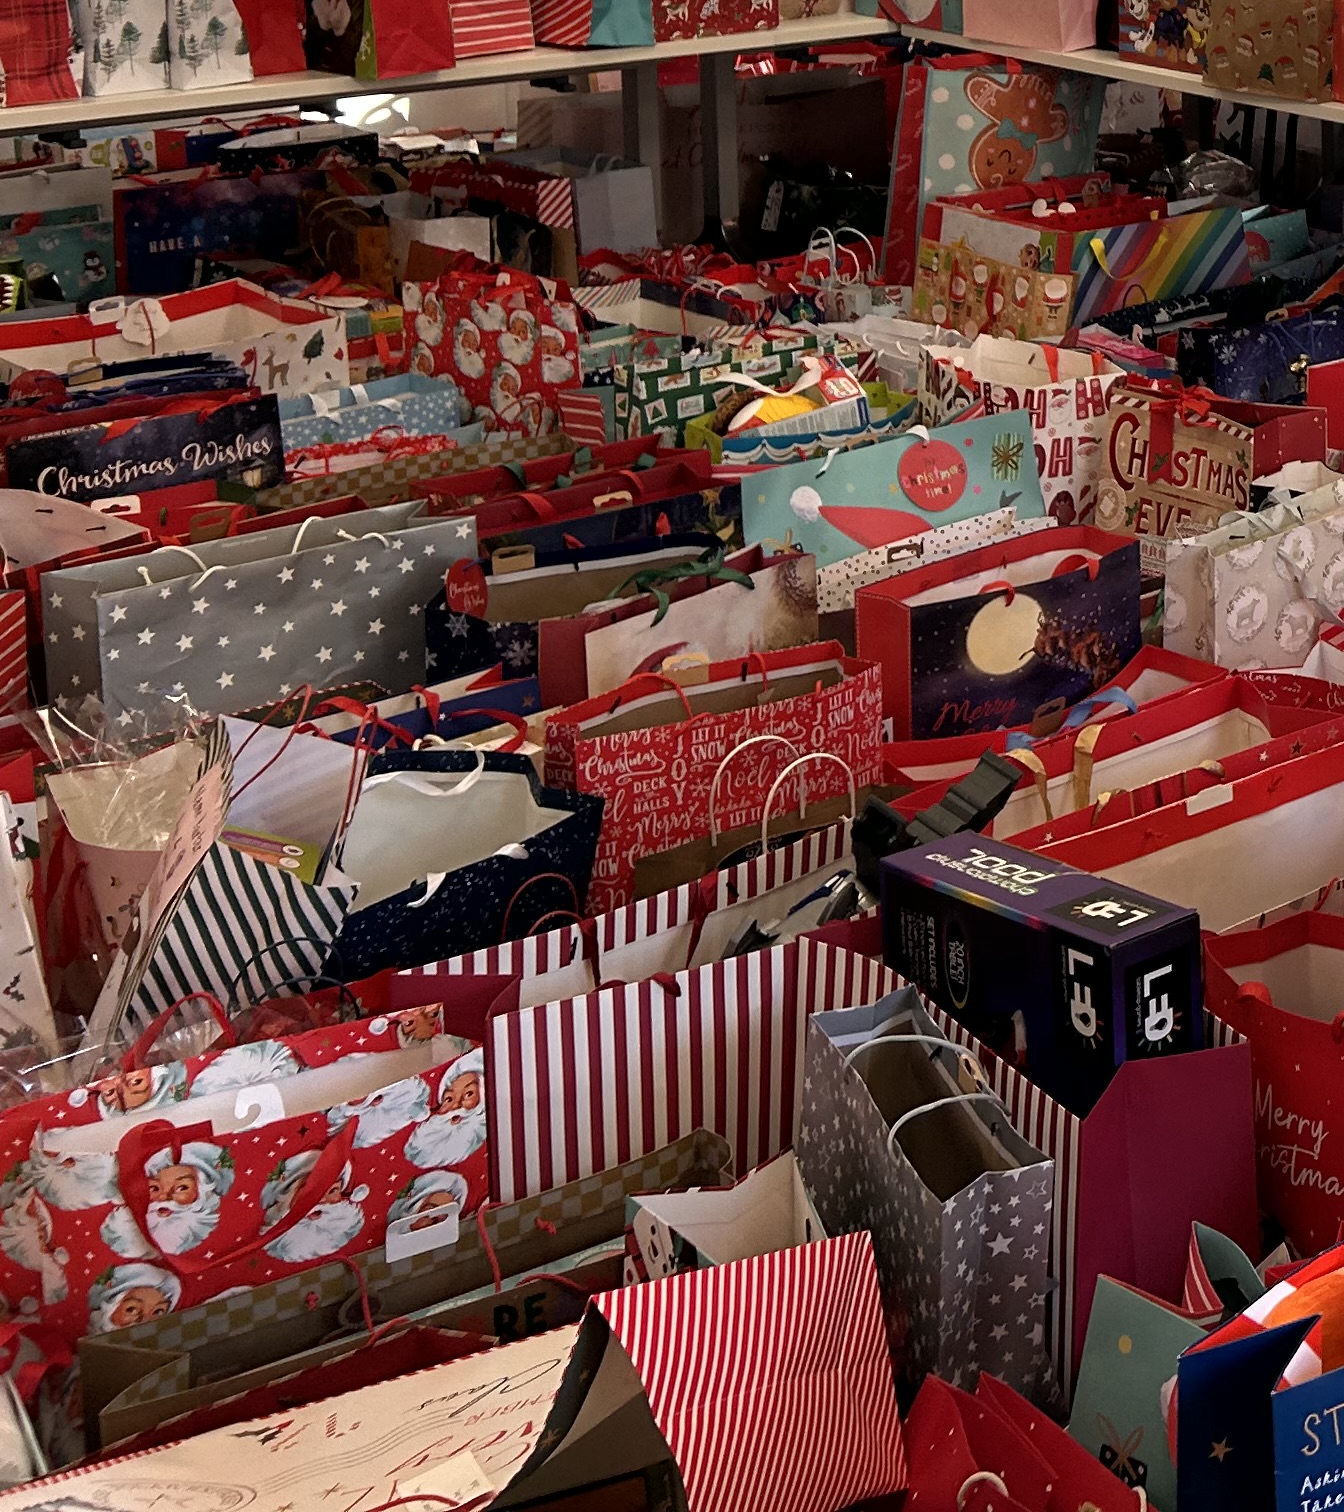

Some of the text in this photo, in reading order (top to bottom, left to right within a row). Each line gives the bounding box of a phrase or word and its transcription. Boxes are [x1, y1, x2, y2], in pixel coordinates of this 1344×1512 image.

[37, 435, 274, 497] Christmas Wishes
[1109, 413, 1249, 511] CHSTMAS
[691, 724, 726, 744] LET IT
[691, 740, 727, 763] SNOW
[633, 776, 667, 794] DECK
[1082, 901, 1149, 927] LED
[1068, 948, 1098, 1038] LED
[1143, 964, 1174, 1042] LED
[1255, 1078, 1329, 1155] Merry
